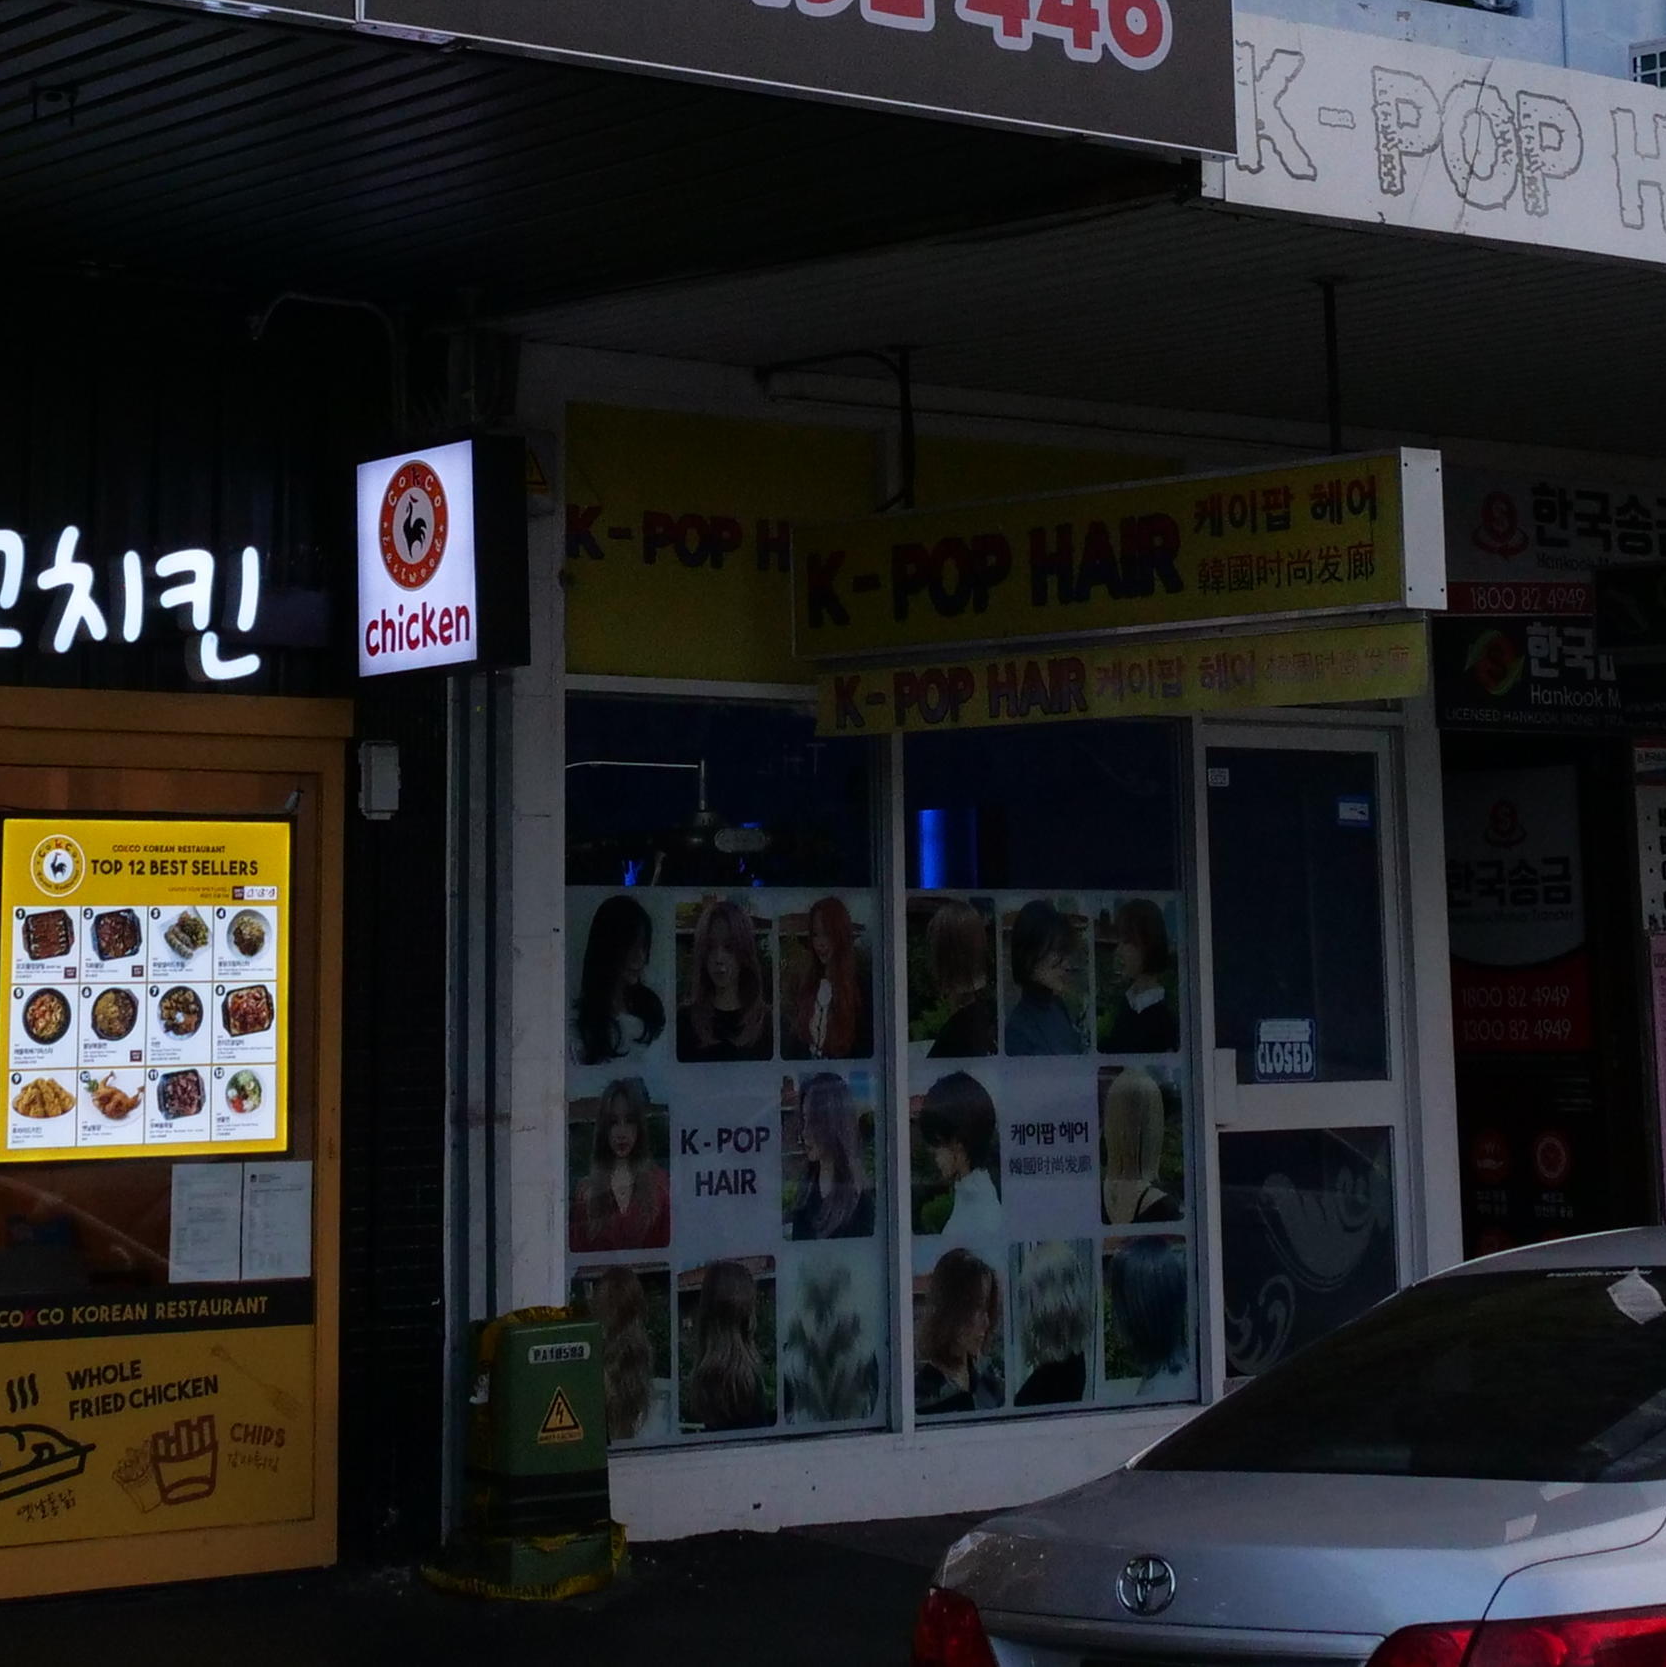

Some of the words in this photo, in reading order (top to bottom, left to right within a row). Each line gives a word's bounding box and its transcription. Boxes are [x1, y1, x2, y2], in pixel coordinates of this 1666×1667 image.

[1193, 485, 1293, 538] 케이팝
[1310, 475, 1378, 524] 헤어
[1029, 512, 1184, 605] HAIR
[1470, 586, 1515, 610] 1800
[1522, 587, 1541, 610] 82
[1548, 587, 1586, 609] 4949
[366, 602, 470, 656] chicken
[988, 656, 1088, 717] HAIR
[1531, 684, 1596, 706] Hankook
[91, 860, 122, 875] TOP
[129, 860, 145, 874] 12
[151, 860, 188, 875] BEST
[192, 861, 258, 875] SELLERS
[1507, 985, 1527, 1006] 82
[1509, 1020, 1529, 1041] 82
[1257, 1042, 1313, 1074] CLOSED
[1011, 1122, 1055, 1144] 케이팝
[1059, 1121, 1089, 1143] 헤어
[695, 1168, 756, 1196] HAIR
[71, 1302, 147, 1325] KOREAN
[155, 1296, 268, 1319] RESTAURANT
[66, 1359, 142, 1390] WHOLE
[69, 1392, 125, 1421] FRIED
[129, 1375, 218, 1409] CHICKEN
[230, 1422, 285, 1448] CHIPS
